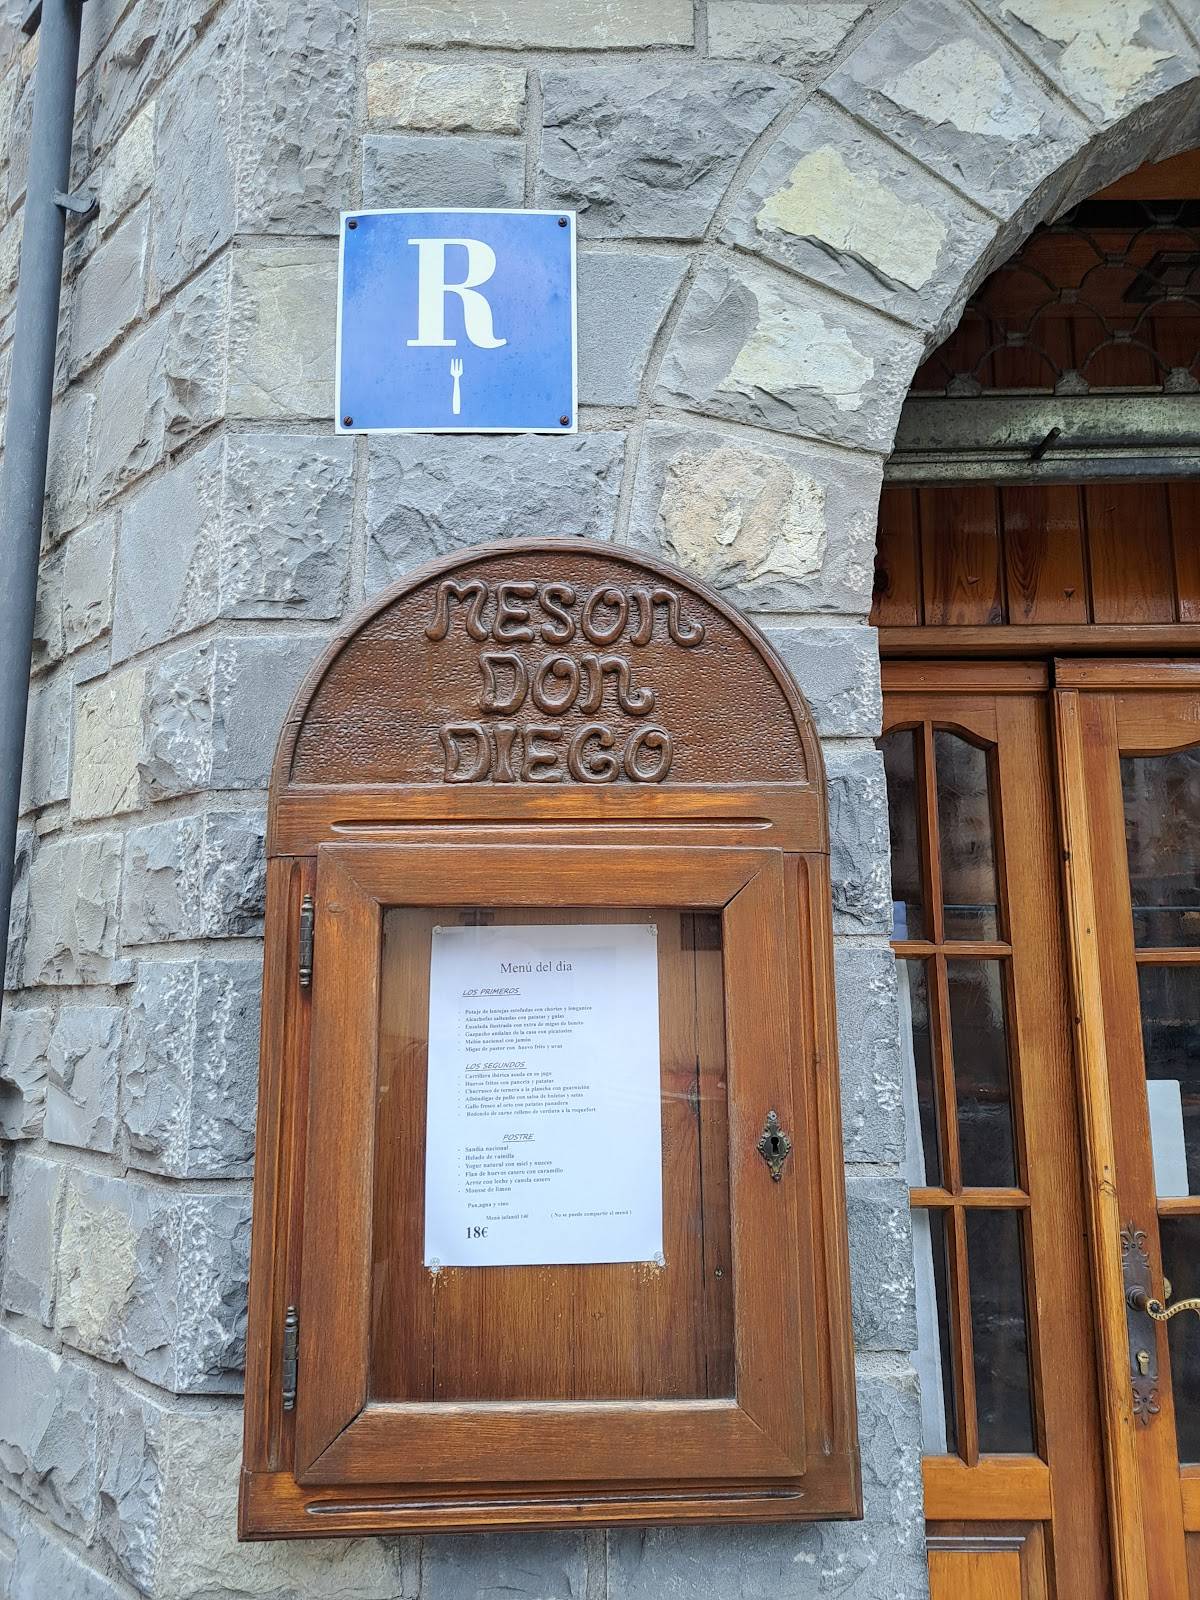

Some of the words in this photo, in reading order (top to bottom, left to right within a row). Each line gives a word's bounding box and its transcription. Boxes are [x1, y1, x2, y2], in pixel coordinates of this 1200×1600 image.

[406, 238, 507, 349] R
[425, 579, 705, 647] MESON
[479, 650, 655, 716] DON
[439, 722, 673, 783] DIEGO
[500, 961, 532, 974] Menú
[536, 961, 552, 973] del
[462, 989, 478, 997] LOS
[480, 987, 520, 996] PRIMEROS
[465, 1008, 481, 1016] Potaje
[465, 1063, 481, 1071] LOS
[483, 1061, 526, 1070] SEGUNDOS
[502, 1133, 534, 1141] POSTRE
[466, 1225, 489, 1240] 18€
